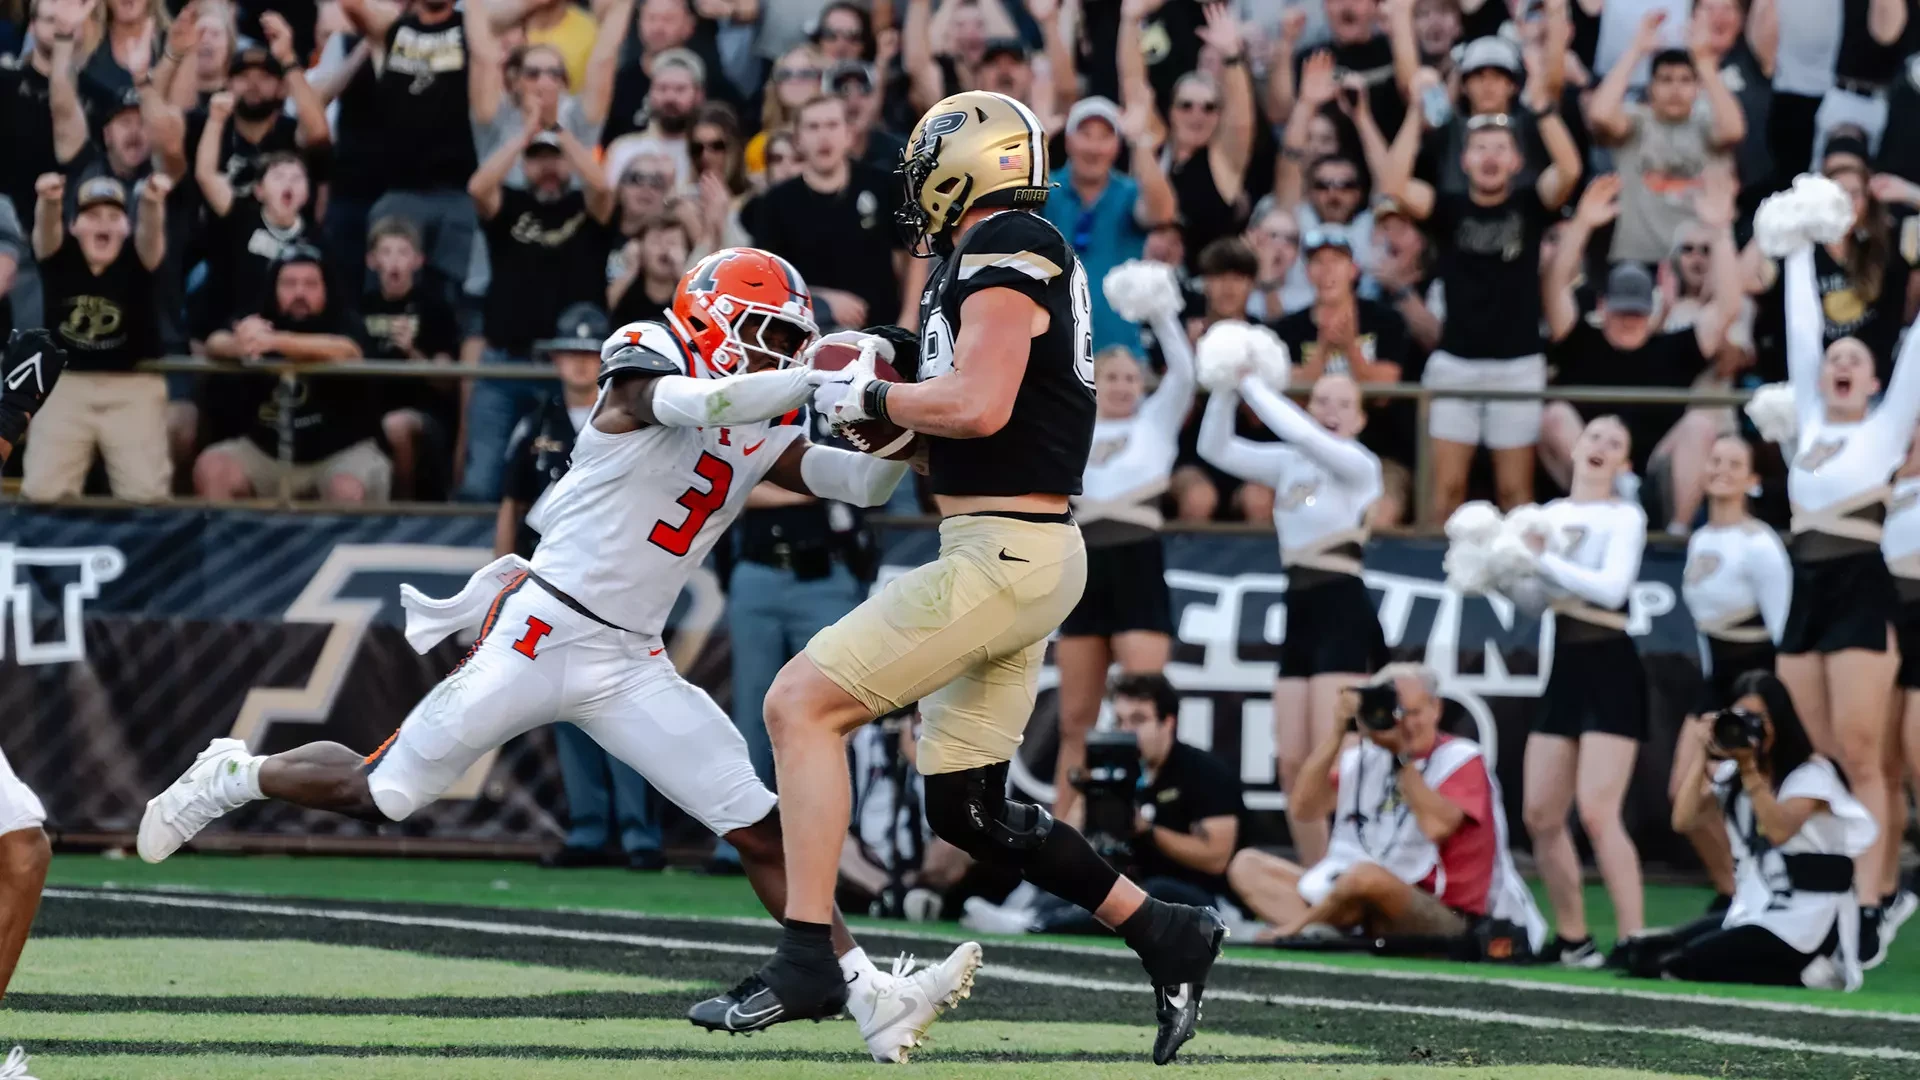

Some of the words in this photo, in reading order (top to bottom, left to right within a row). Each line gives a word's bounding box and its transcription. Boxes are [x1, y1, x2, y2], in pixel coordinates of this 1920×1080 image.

[718, 427, 731, 447] I
[647, 449, 734, 558] 3
[512, 614, 554, 661] I
